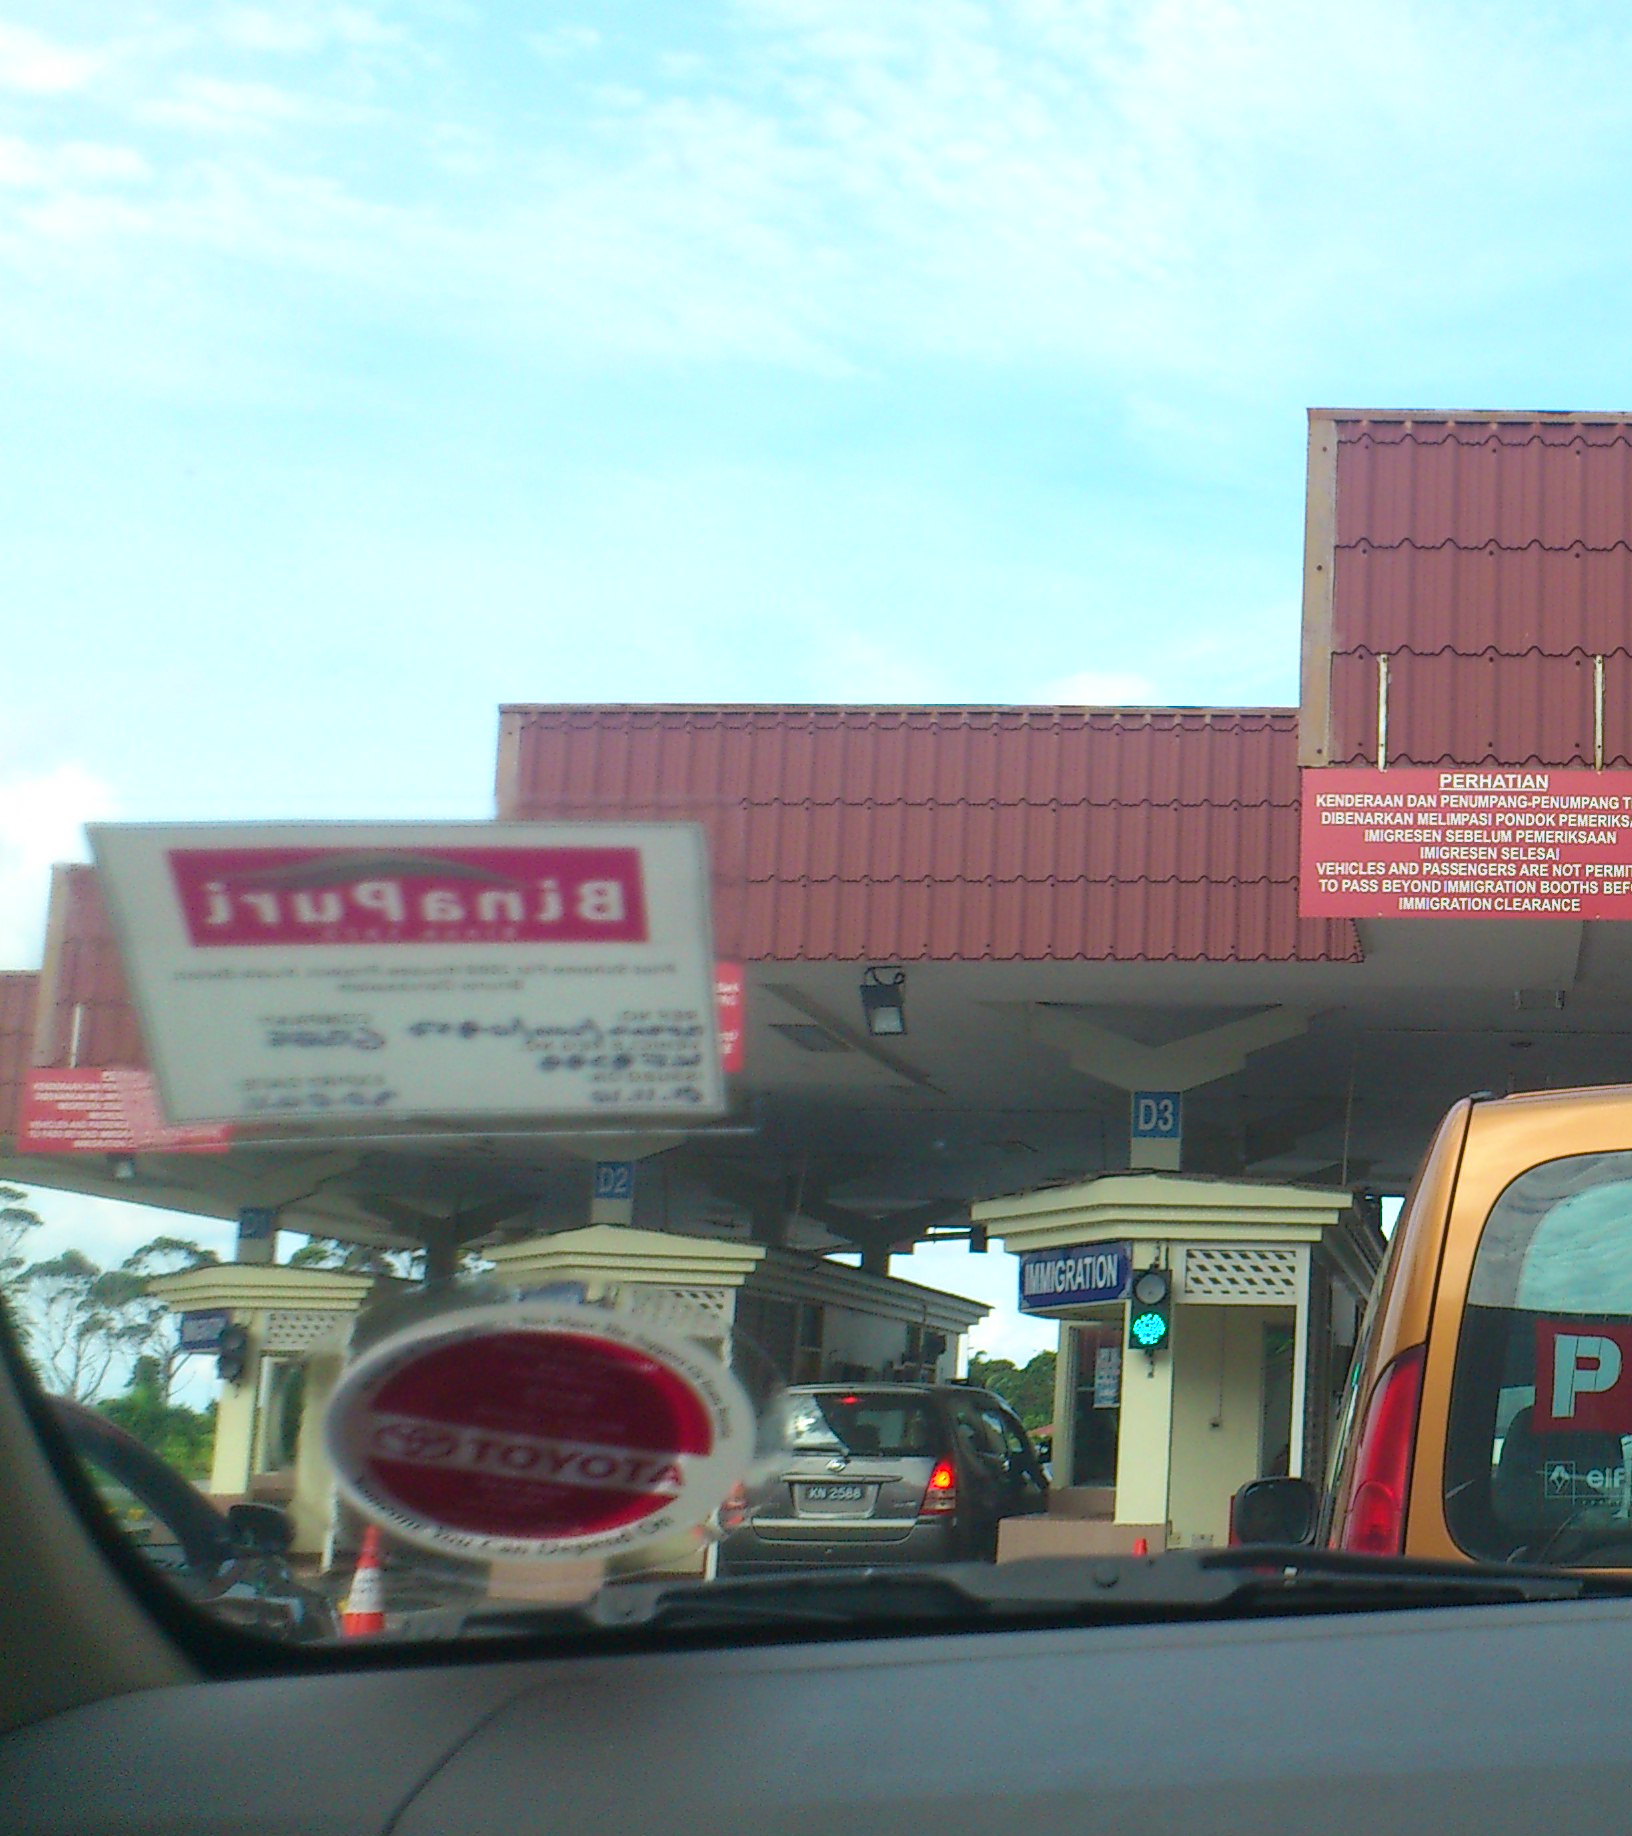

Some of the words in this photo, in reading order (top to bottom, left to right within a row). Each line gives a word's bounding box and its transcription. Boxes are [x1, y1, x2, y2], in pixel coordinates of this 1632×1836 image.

[1439, 773, 1549, 790] PERHATIAN
[1316, 794, 1403, 808] KENDERAAN
[1407, 795, 1437, 808] DAN
[1440, 795, 1620, 810] PENUMPANG-PENUMPANG
[1321, 812, 1413, 826] DIBENARKAN
[1417, 813, 1492, 826] MELIMPASI
[1496, 813, 1556, 827] PONDOK
[1364, 829, 1442, 843] IMIGRESEN
[1445, 830, 1512, 844] SEBELUM
[1516, 830, 1617, 844] PEMERIKSAAN
[1420, 846, 1498, 860] IMIGRESEN
[1501, 847, 1560, 861] SELESAI
[1316, 862, 1386, 876] VEHICLES
[1388, 863, 1419, 876] AND
[1422, 863, 1517, 877] PASSENGERS
[1519, 864, 1549, 877] ARE
[1552, 864, 1582, 877] NOT
[1319, 879, 1339, 893] TO
[1341, 879, 1379, 893] PASS
[1382, 880, 1442, 894] BEYOND
[1444, 880, 1536, 894] IMMIGRATION
[1540, 880, 1599, 894] BOOTHS
[1399, 897, 1492, 911] IMMIGRATION
[1494, 898, 1581, 912] CLEARANCE
[1138, 1098, 1174, 1132] D3
[599, 1166, 629, 1193] D2
[1023, 1253, 1119, 1296] IMMIGRATION
[1551, 1333, 1623, 1419] P
[470, 1437, 685, 1488] TOYOTA
[1586, 1466, 1625, 1489] elf
